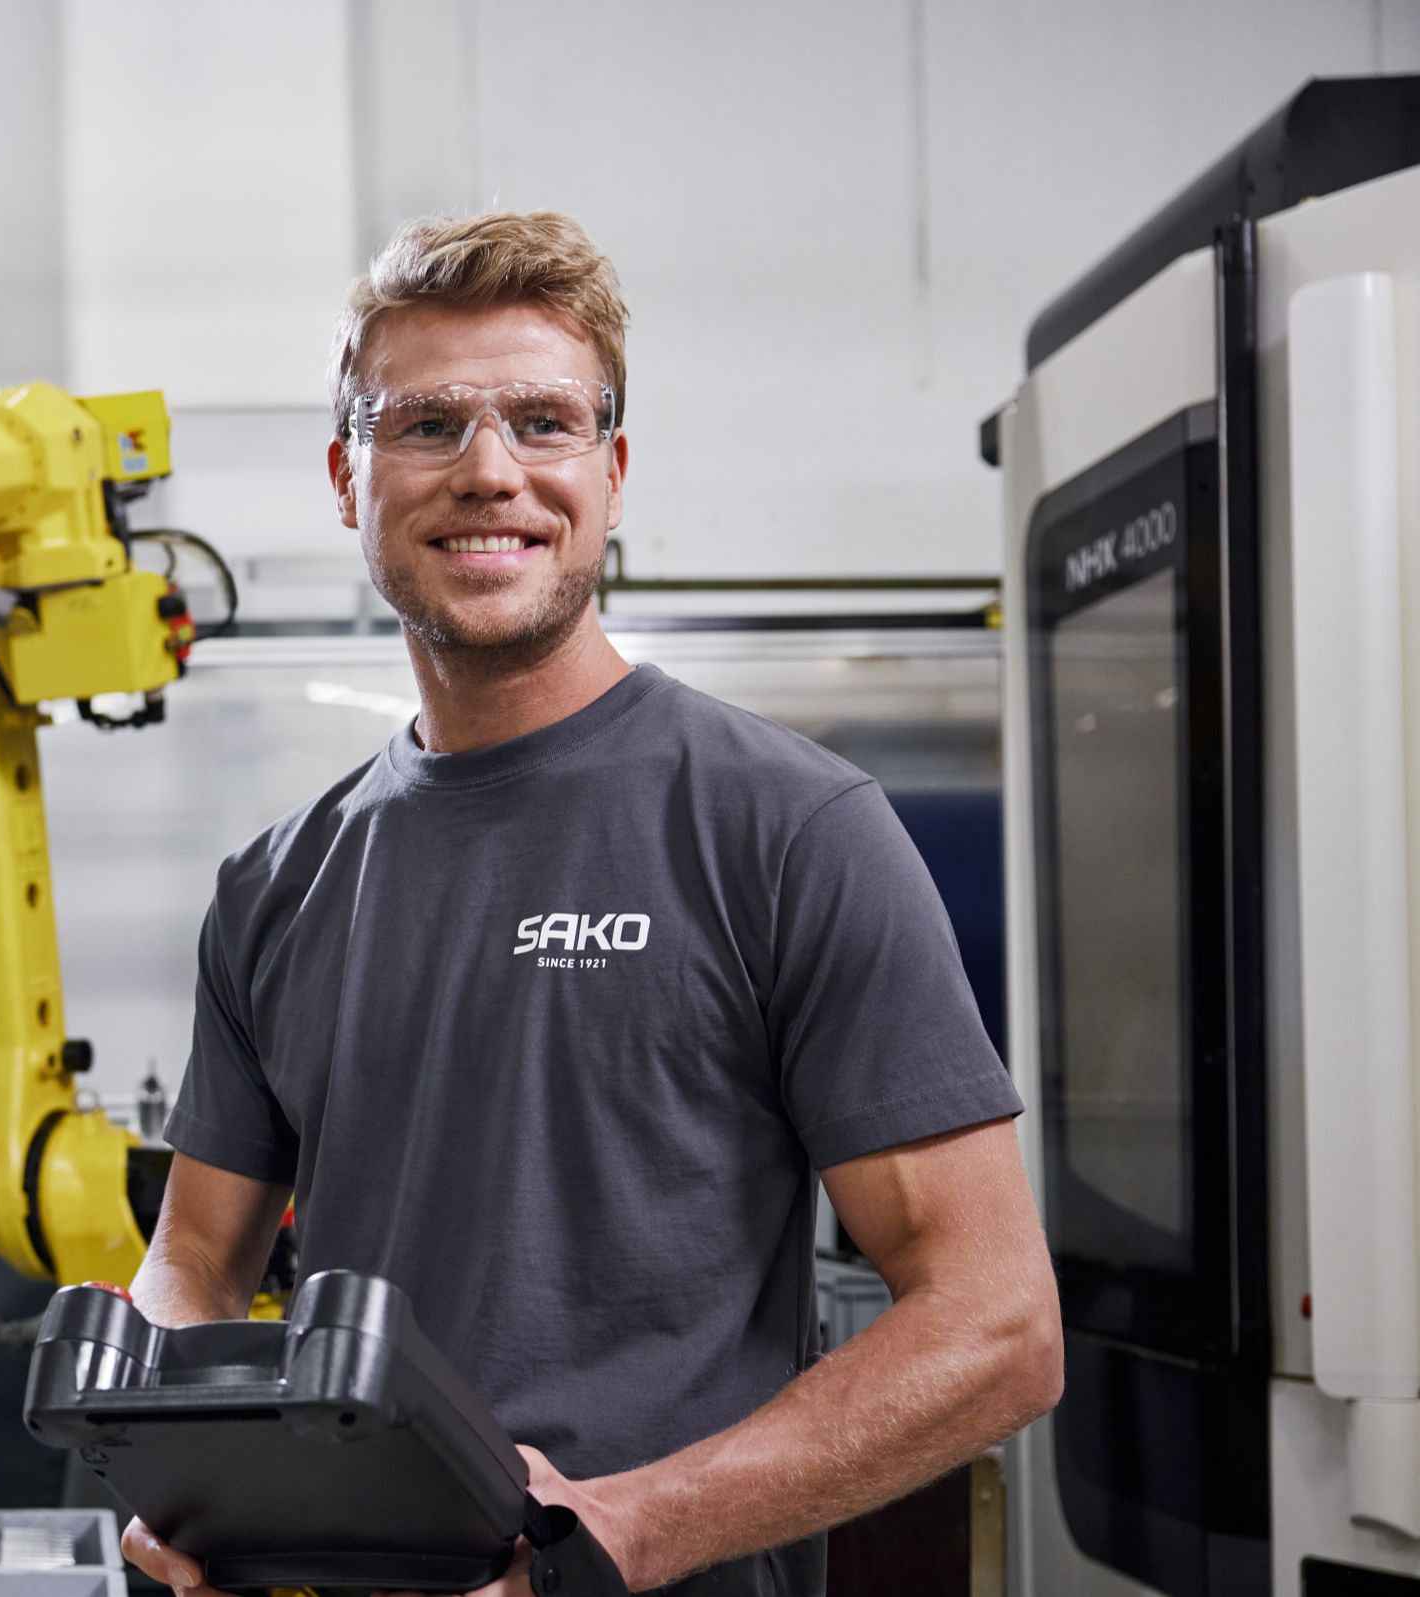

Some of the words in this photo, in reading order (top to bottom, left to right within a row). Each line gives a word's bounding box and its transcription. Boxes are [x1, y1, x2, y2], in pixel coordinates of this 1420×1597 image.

[513, 912, 651, 955] SAKO
[537, 956, 576, 969] SINCE
[579, 957, 607, 969] 1921
